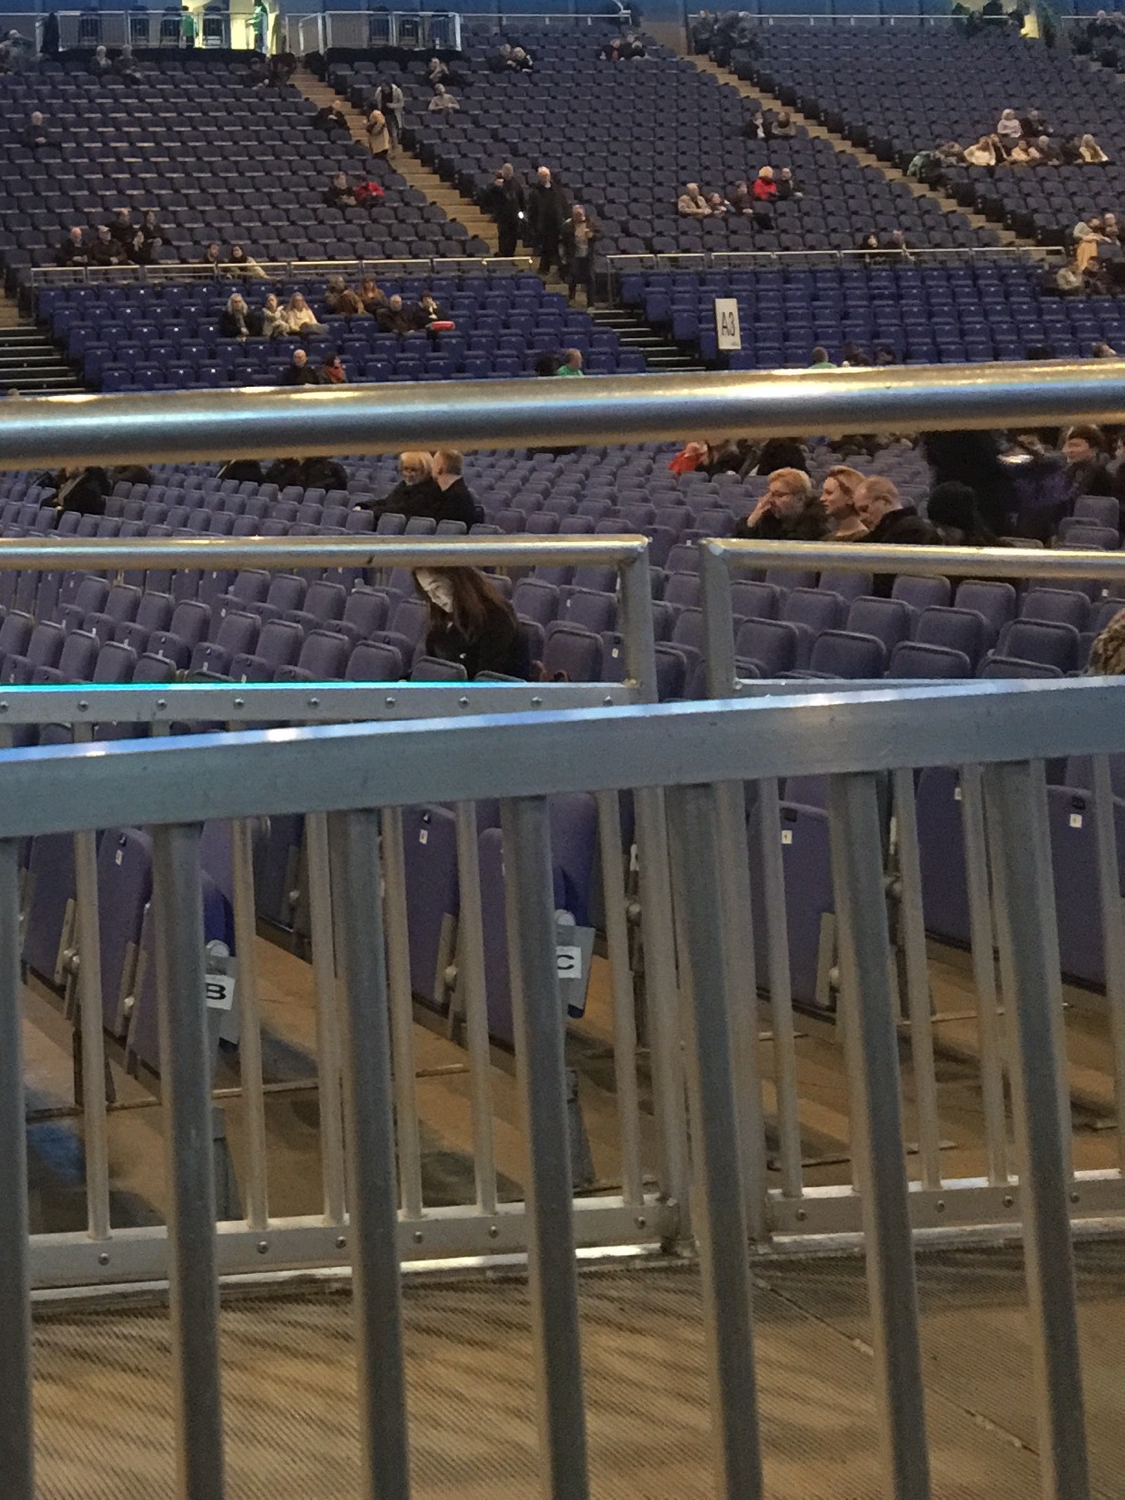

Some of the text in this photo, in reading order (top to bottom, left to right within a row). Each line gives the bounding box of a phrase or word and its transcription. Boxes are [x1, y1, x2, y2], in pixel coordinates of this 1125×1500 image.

[721, 311, 735, 336] A3
[557, 954, 575, 970] C
[205, 982, 227, 1000] B
